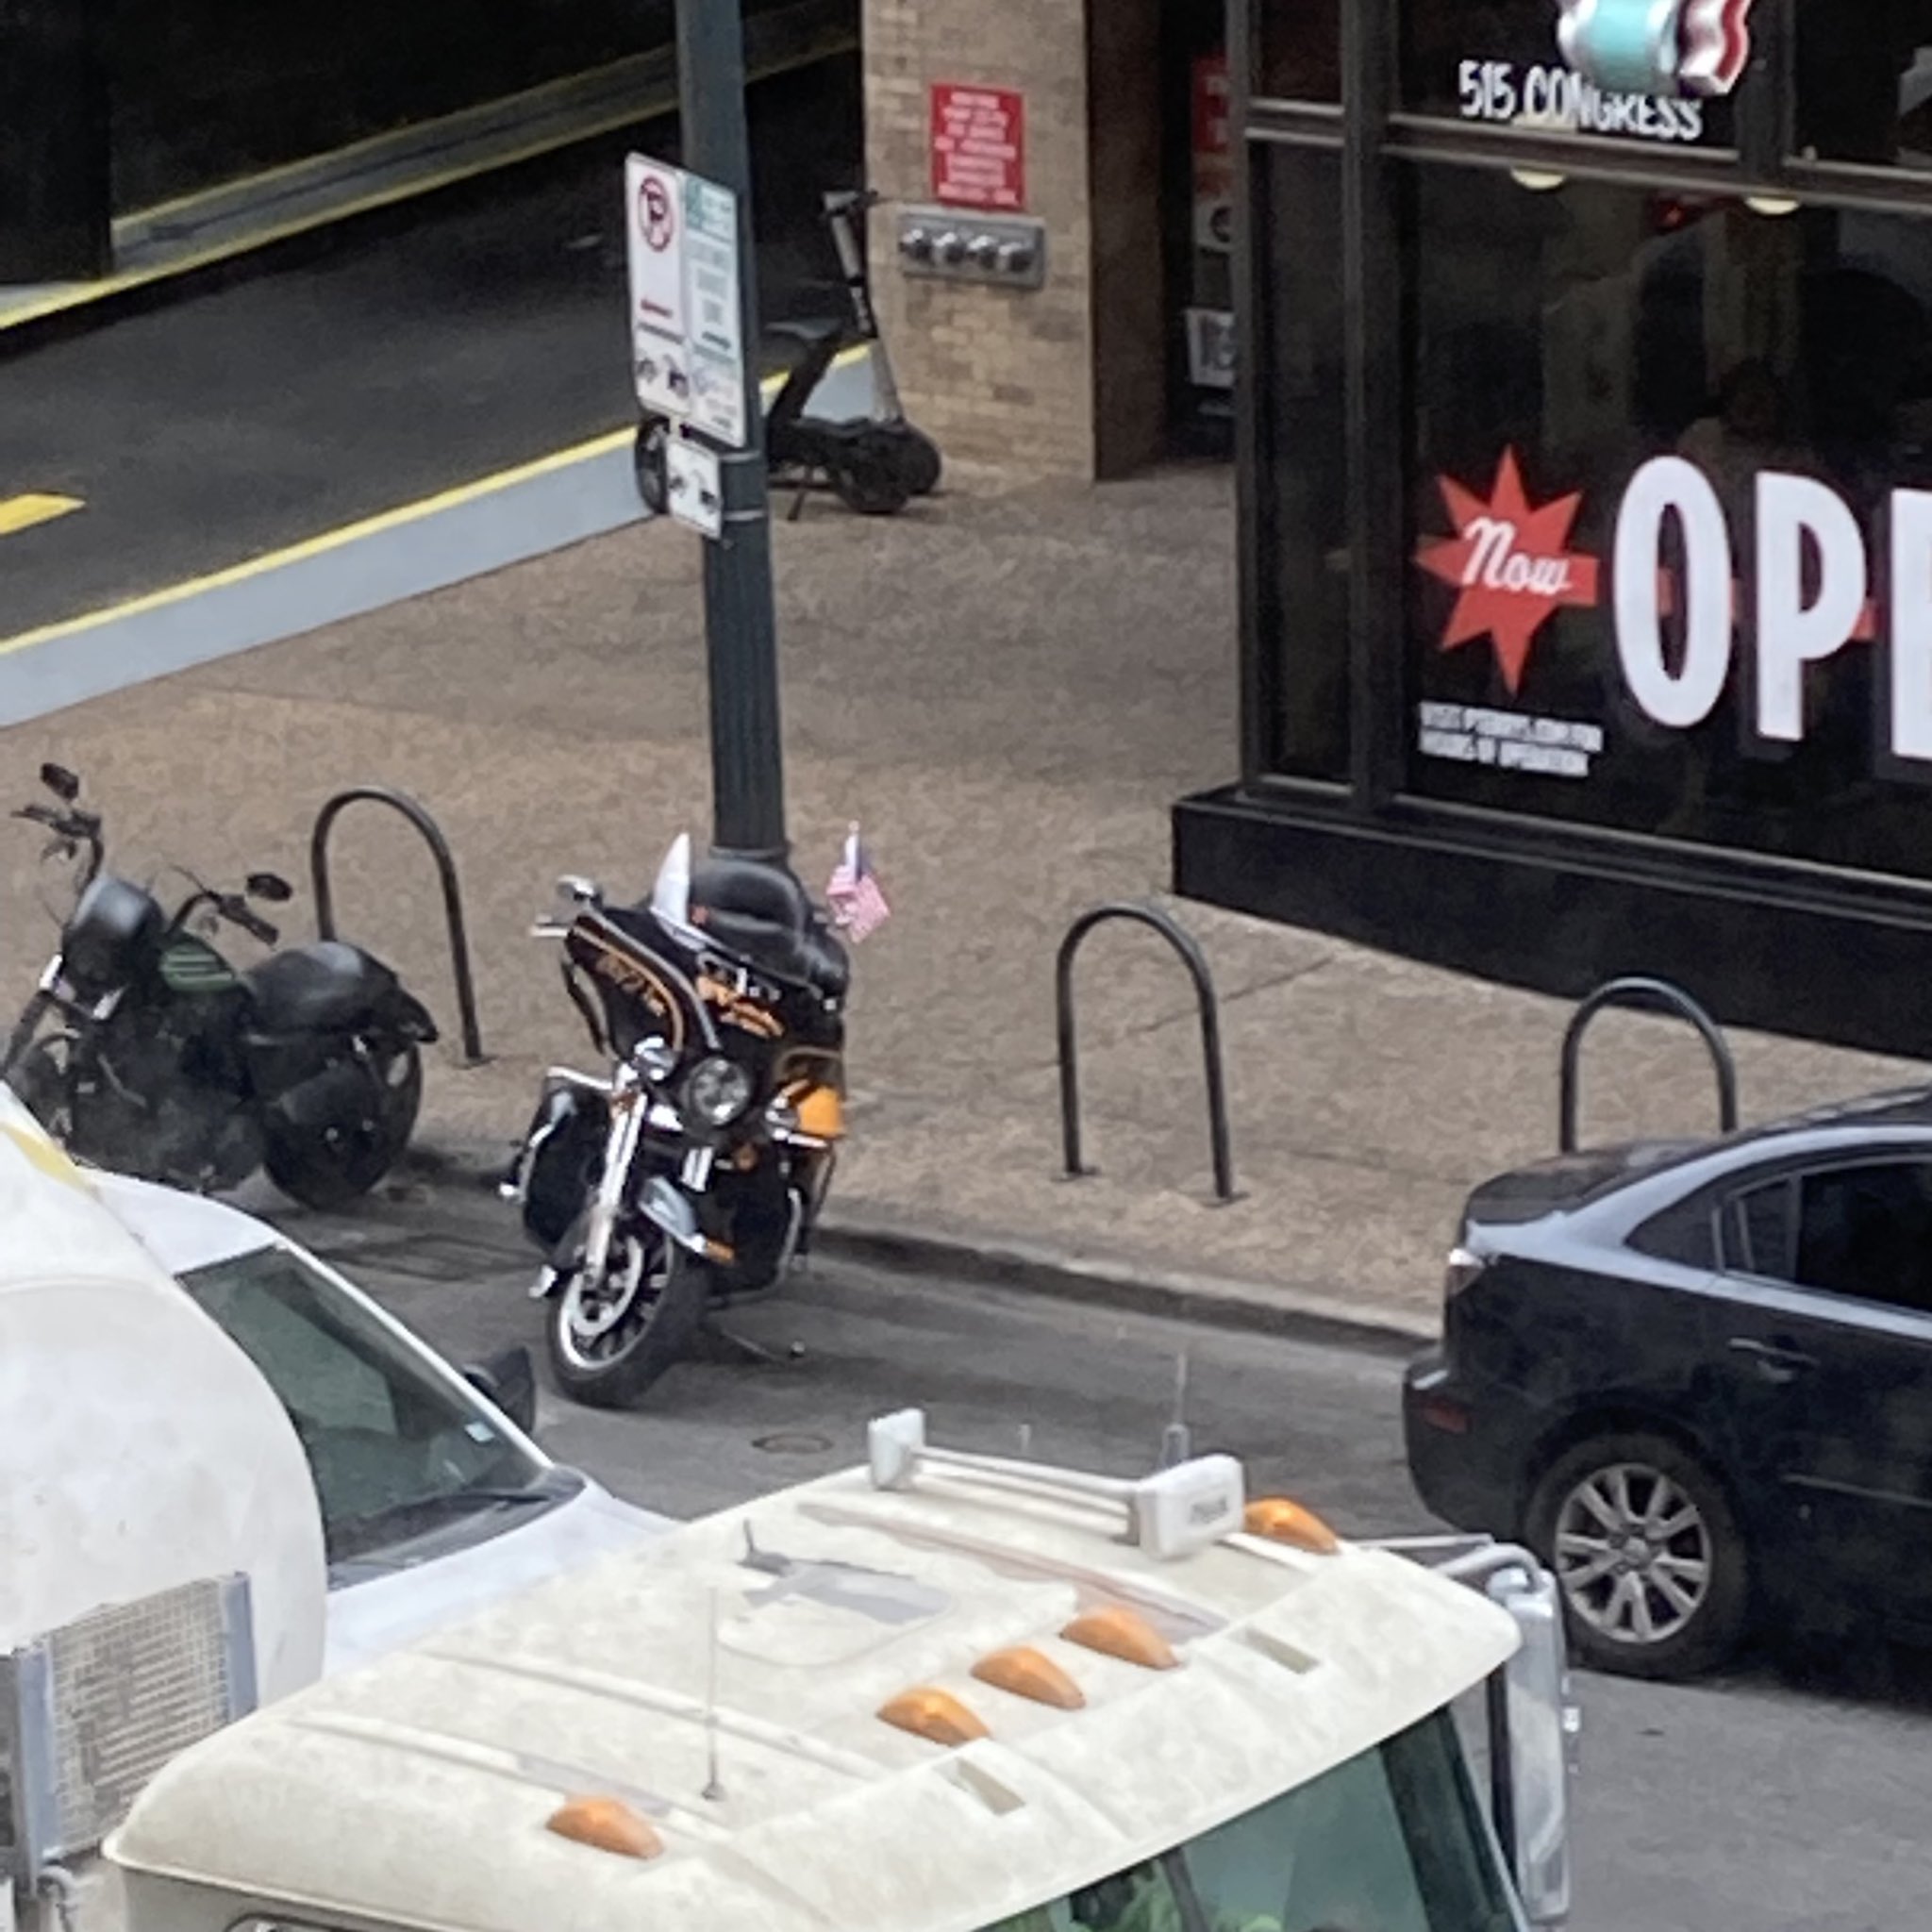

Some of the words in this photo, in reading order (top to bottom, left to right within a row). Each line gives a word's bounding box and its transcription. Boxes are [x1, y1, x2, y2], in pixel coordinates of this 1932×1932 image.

[1459, 59, 1515, 119] 515
[1523, 65, 1703, 141] CONGRESS
[1461, 515, 1573, 595] Now
